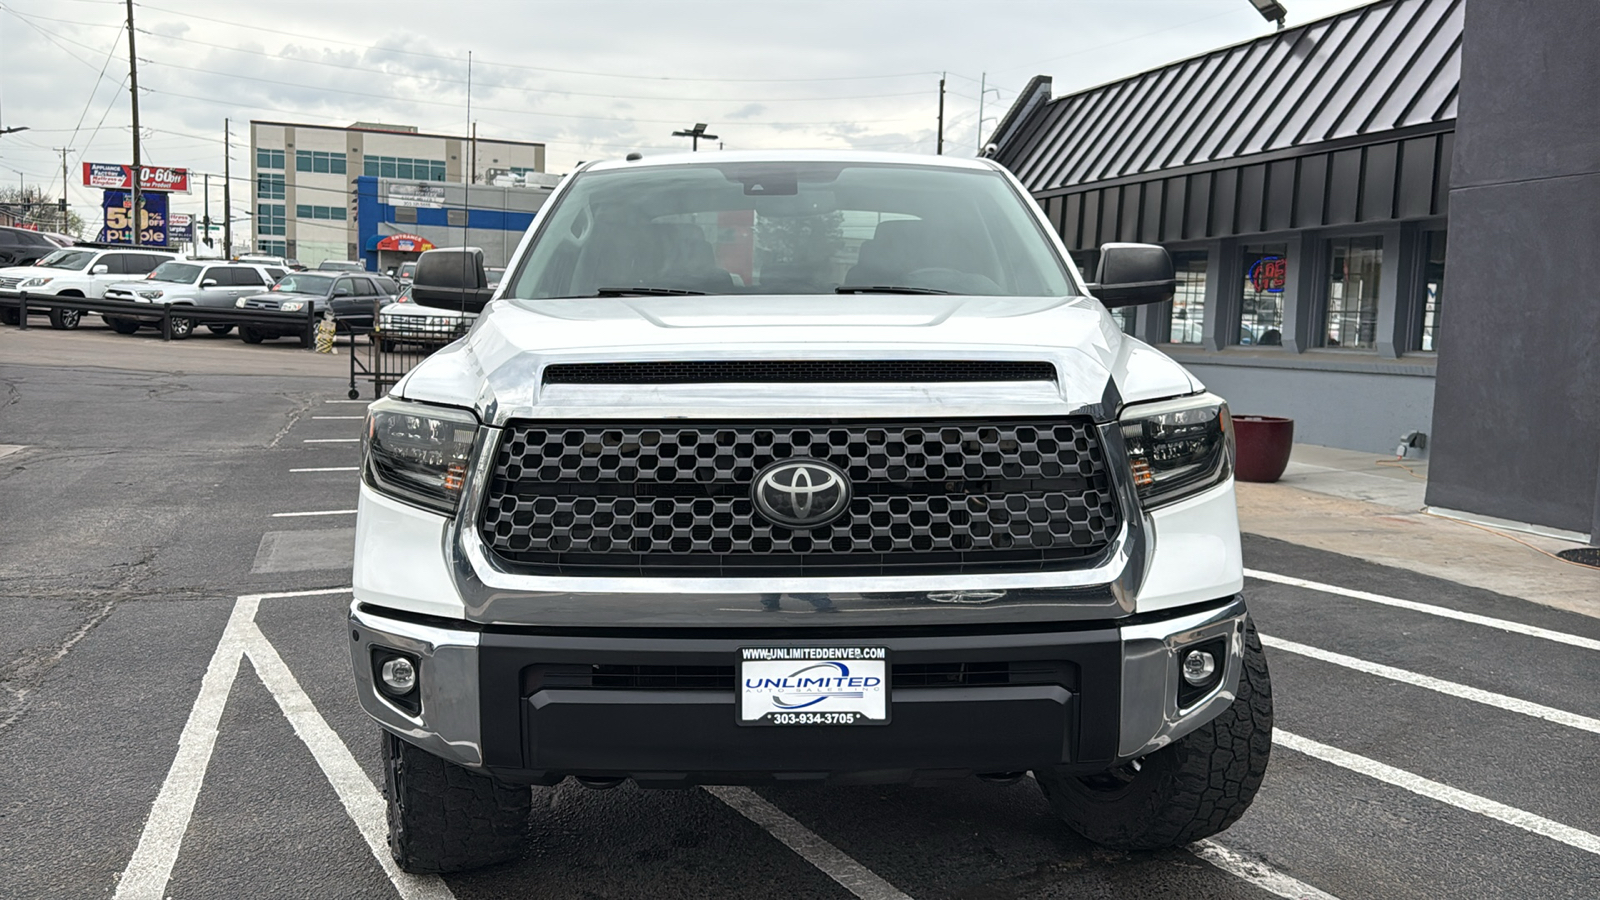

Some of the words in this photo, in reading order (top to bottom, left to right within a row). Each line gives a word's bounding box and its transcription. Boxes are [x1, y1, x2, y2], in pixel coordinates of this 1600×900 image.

[107, 229, 165, 242] puple
[391, 234, 422, 242] ENTRANCE
[1254, 258, 1286, 292] OPE
[743, 648, 885, 659] WWWUNLIMITEDDENVER.COM
[746, 677, 881, 688] UNLIMITED
[774, 713, 854, 724] 303-934-3705
